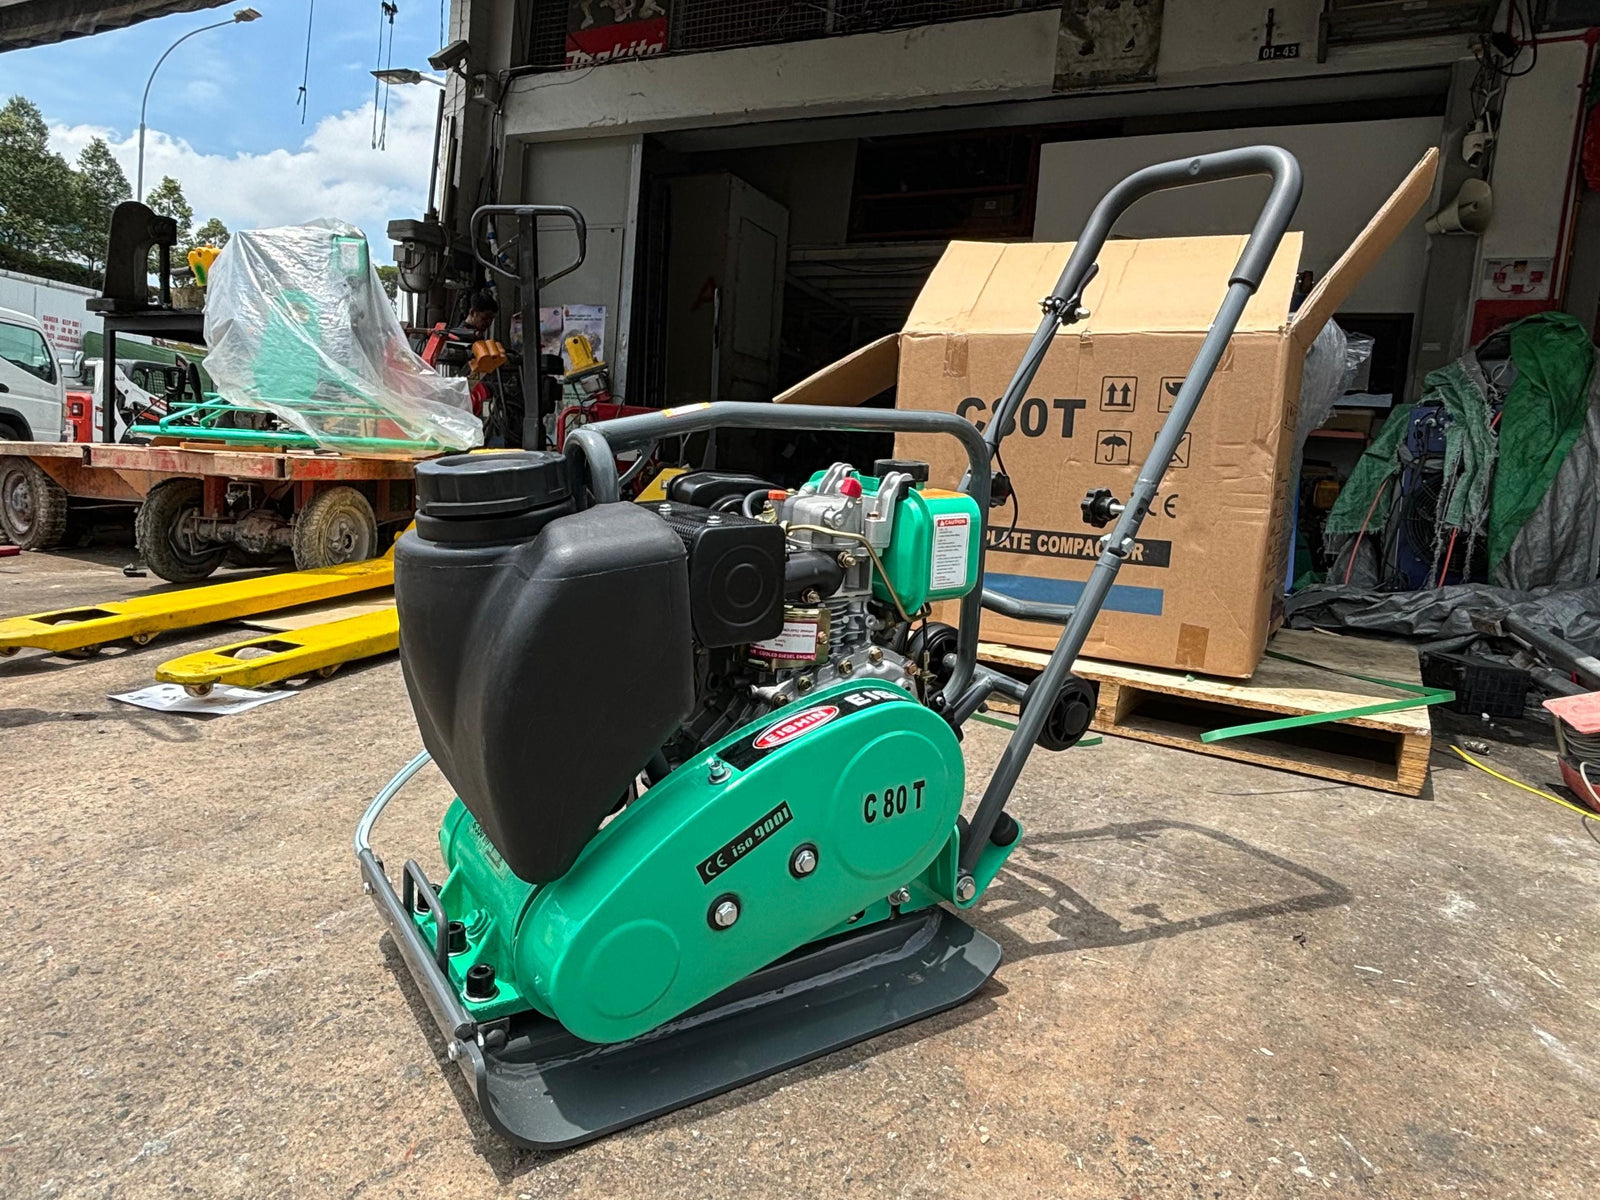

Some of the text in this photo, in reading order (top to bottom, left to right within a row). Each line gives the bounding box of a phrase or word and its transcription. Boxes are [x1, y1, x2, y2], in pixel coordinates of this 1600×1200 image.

[1262, 46, 1297, 59] 01-43
[1037, 534, 1144, 562] COMPACR
[764, 710, 829, 744] EISHIN
[863, 779, 926, 824] C 80 T
[754, 806, 790, 841] 9001
